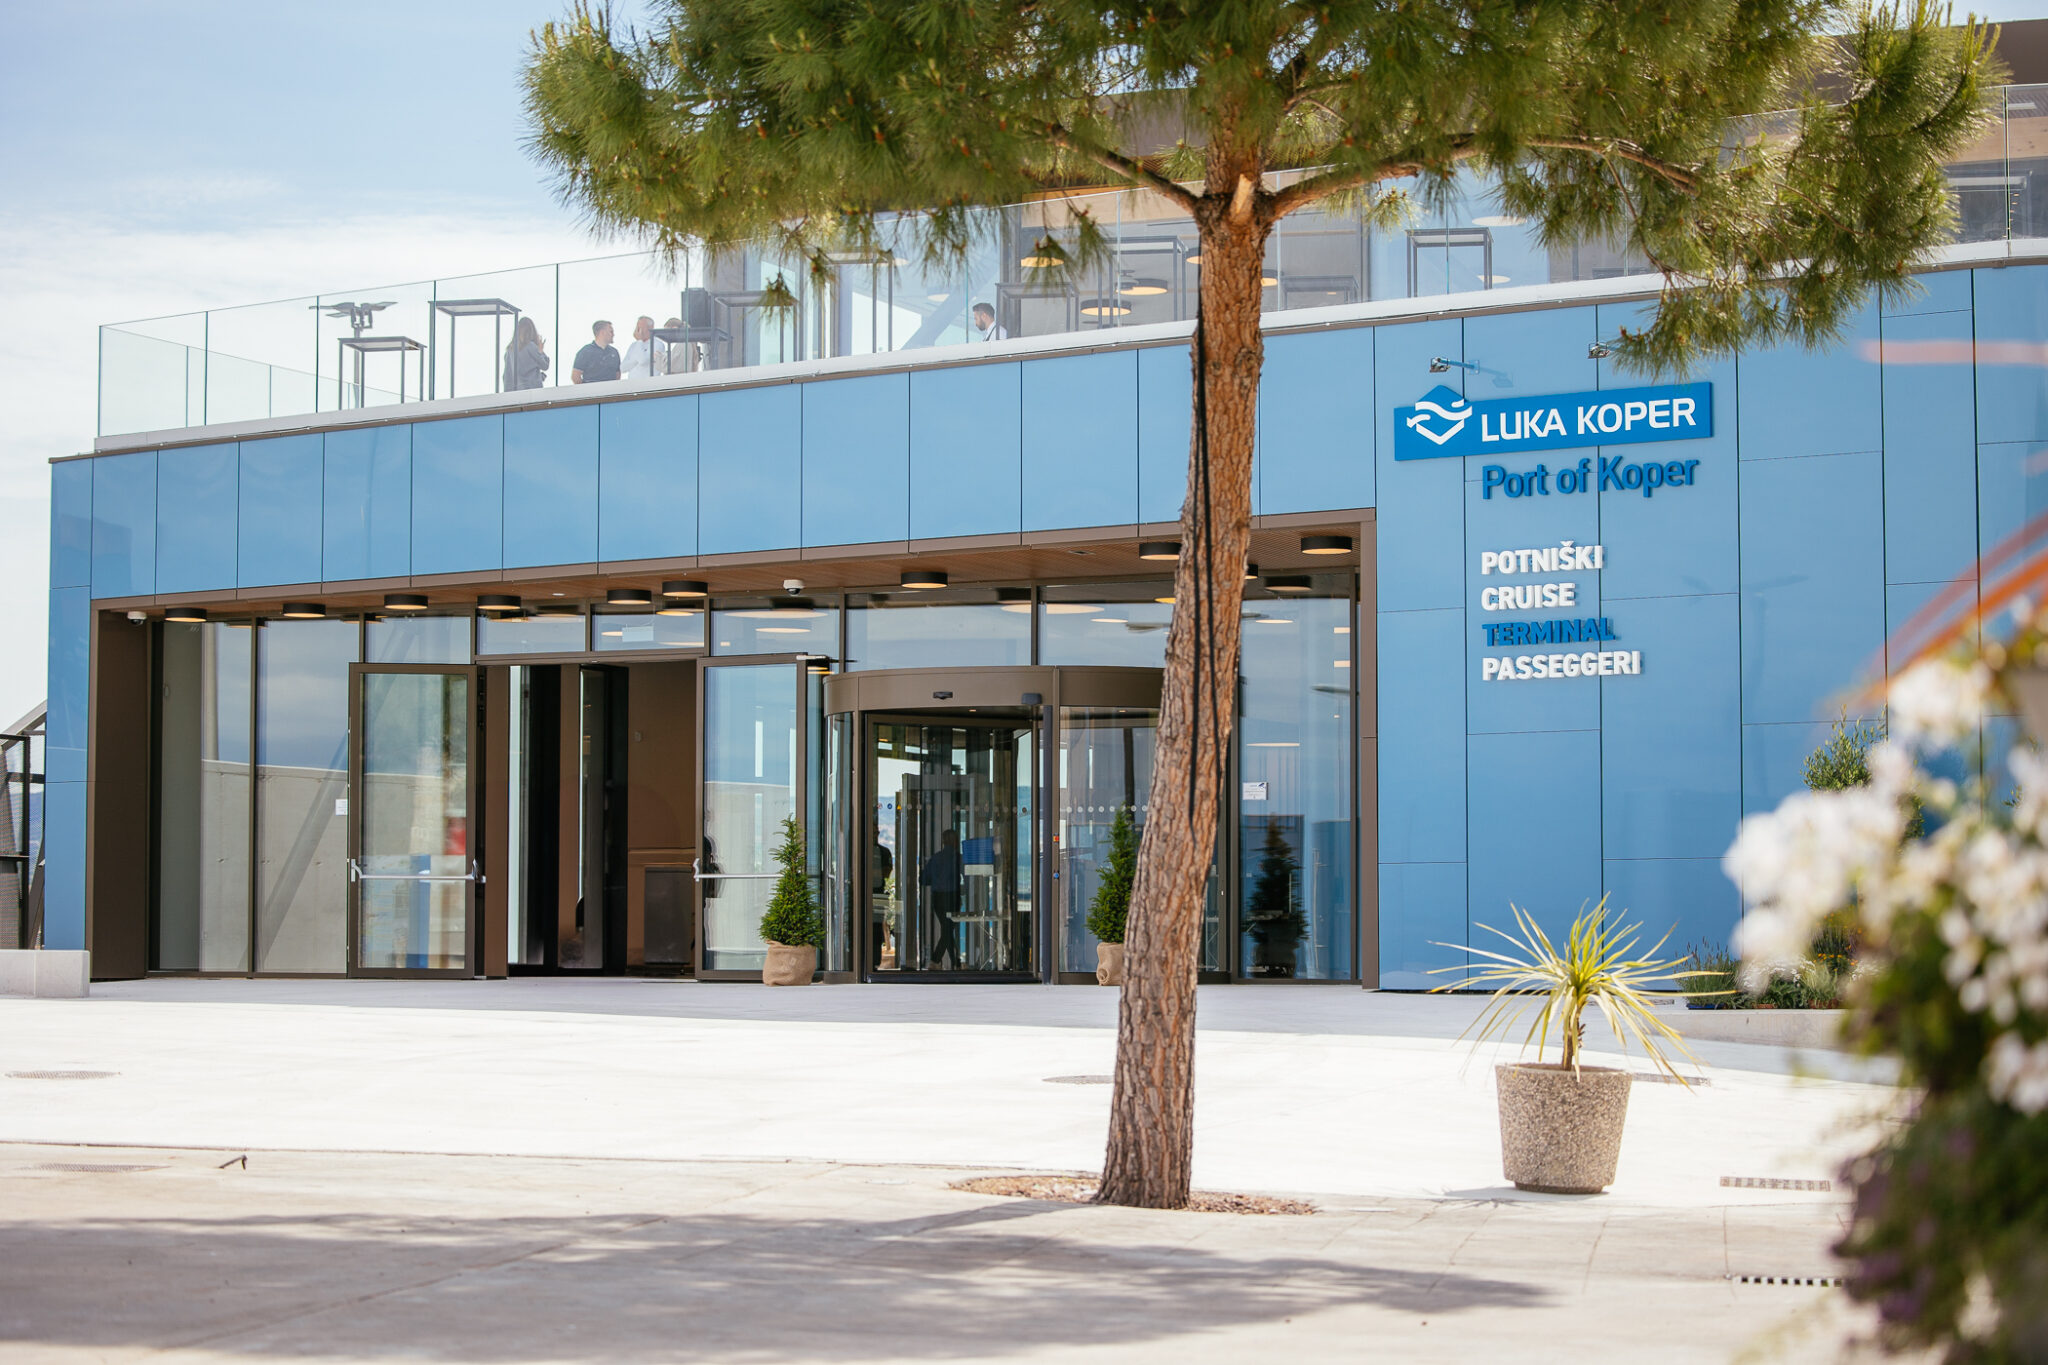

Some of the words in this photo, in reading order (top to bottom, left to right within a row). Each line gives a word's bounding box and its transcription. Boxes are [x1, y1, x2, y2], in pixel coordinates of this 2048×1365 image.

[1481, 408, 1567, 442] LUKA
[1577, 398, 1697, 434] KOPER
[1482, 464, 1549, 500] Port
[1556, 457, 1591, 494] of
[1598, 455, 1700, 498] Koper
[1481, 540, 1603, 575] POTNIŠKI
[1481, 582, 1576, 611] CRUISE
[1482, 617, 1617, 647] TERMINAL
[1482, 650, 1642, 681] PASSEGGERI
